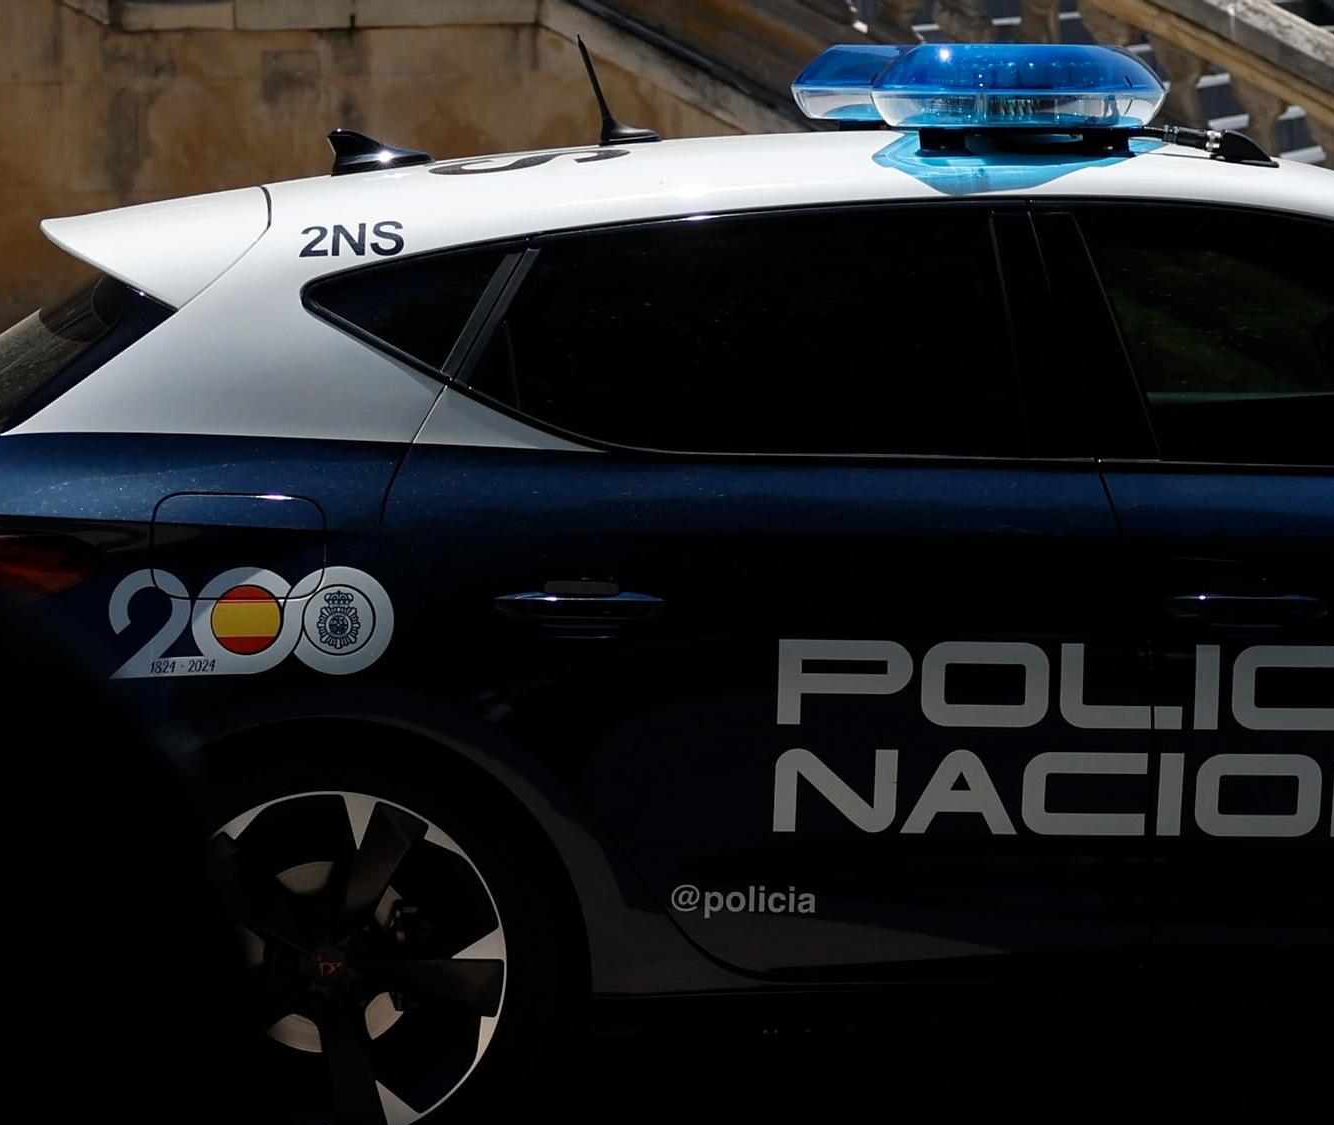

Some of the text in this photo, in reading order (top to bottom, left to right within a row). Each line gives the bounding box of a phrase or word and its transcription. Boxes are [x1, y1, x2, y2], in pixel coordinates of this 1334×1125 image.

[299, 220, 405, 259] 2NS
[149, 659, 216, 674] 1824 2024
[671, 884, 816, 919] @policia
